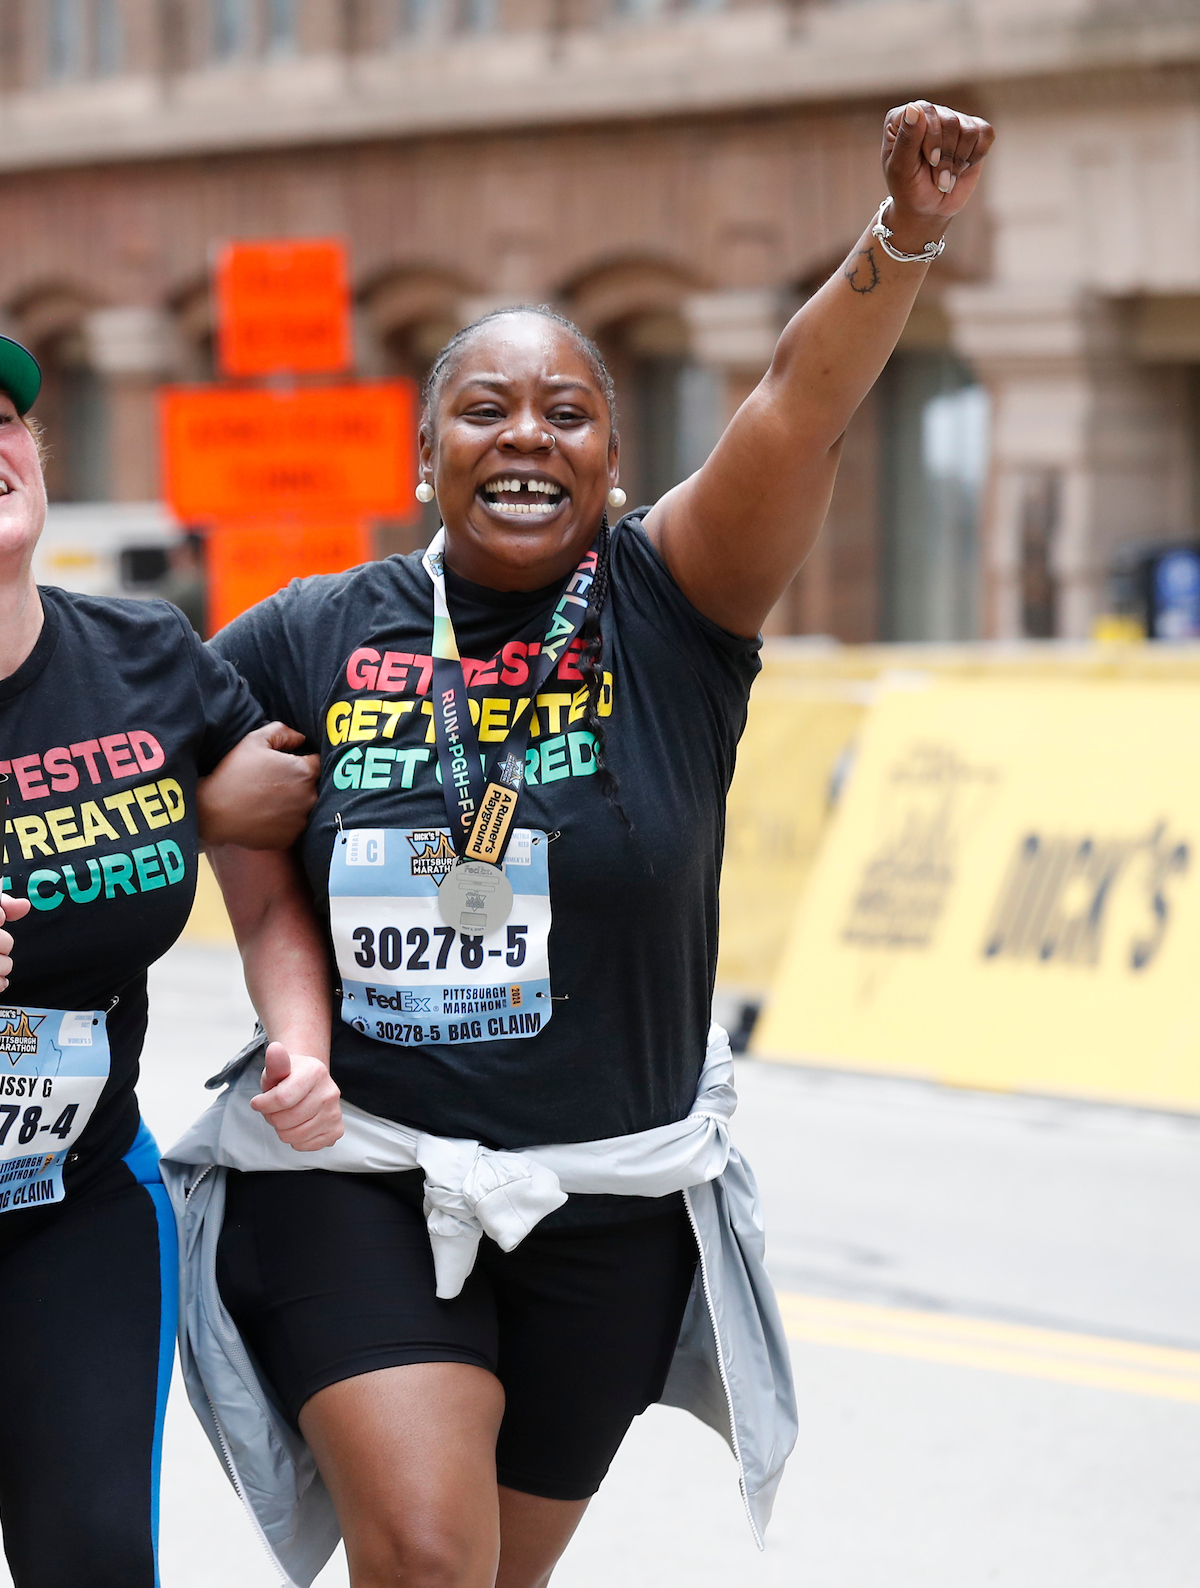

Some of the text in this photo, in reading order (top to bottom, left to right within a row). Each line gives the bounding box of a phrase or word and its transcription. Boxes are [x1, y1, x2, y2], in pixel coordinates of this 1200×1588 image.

[346, 637, 602, 695] GET TESE
[326, 699, 415, 747] GET
[332, 746, 431, 790] GET
[435, 730, 601, 786] RED
[441, 688, 475, 834] RUN+PGH=FU
[502, 794, 512, 804] A
[472, 790, 502, 854] Playground
[485, 804, 509, 854] Runner's
[414, 832, 435, 841] DICK'S
[366, 839, 377, 862] C
[413, 858, 455, 867] PITTSBUR
[26, 839, 186, 912] CURED
[413, 865, 452, 874] MARATH
[352, 925, 529, 971] 30278-5
[365, 987, 431, 1012] FedEx
[443, 987, 506, 1000] PITTSBURGH
[443, 1000, 503, 1014] MARATHON
[376, 1020, 440, 1043] 30278-5
[448, 1020, 482, 1041] BAG
[487, 1012, 541, 1036] CLAIM
[42, 1078, 52, 1098] G
[12, 1178, 54, 1205] CLAIM
